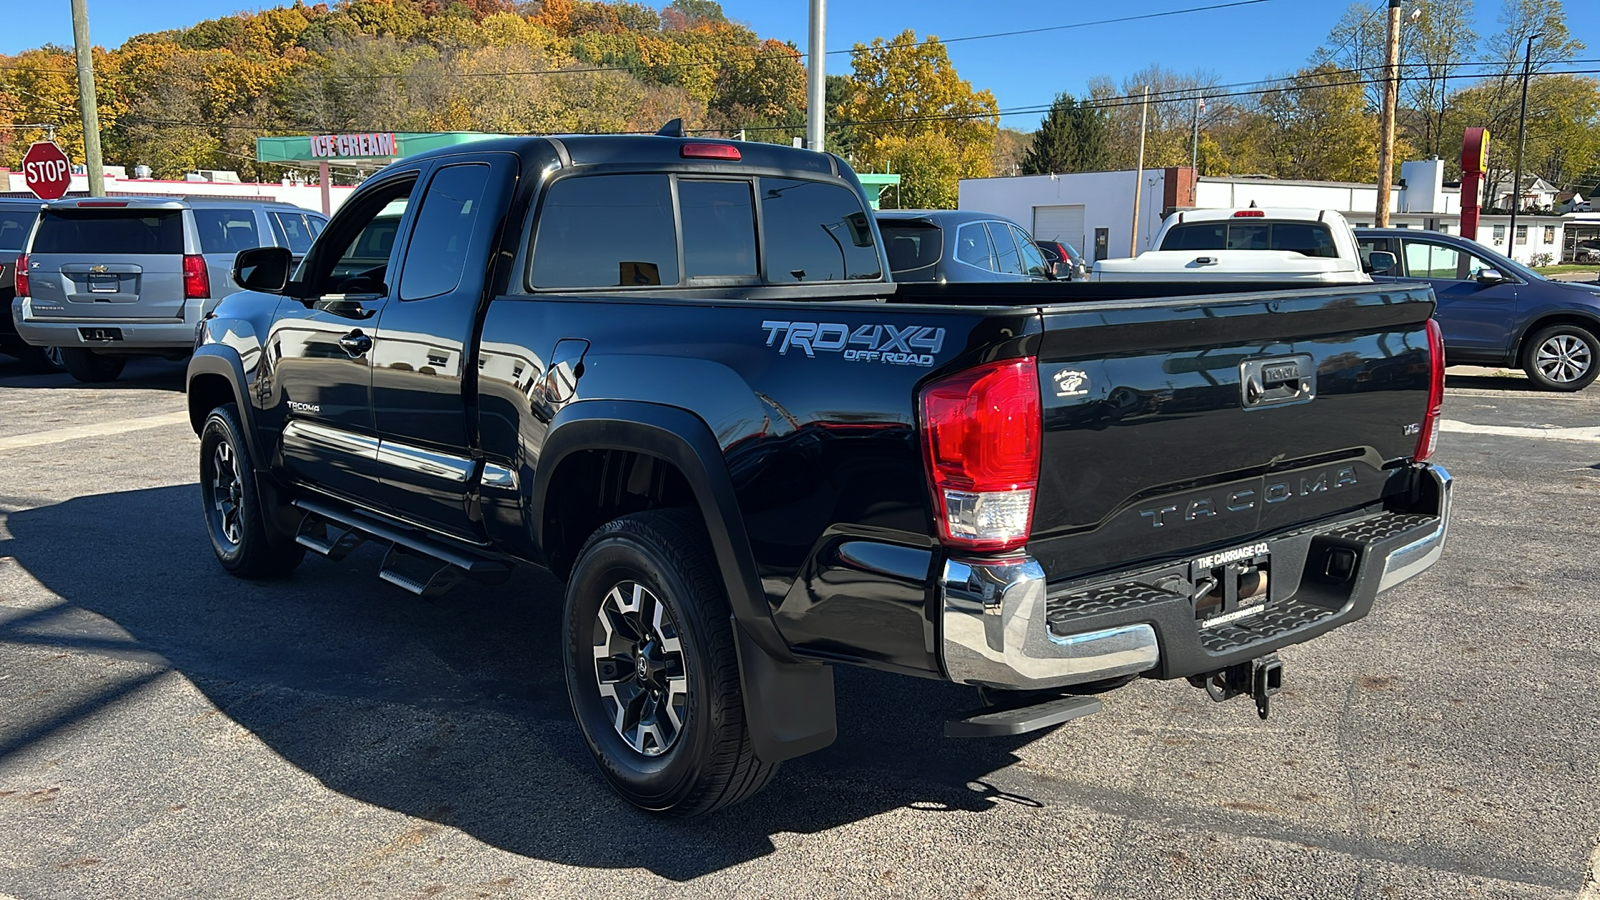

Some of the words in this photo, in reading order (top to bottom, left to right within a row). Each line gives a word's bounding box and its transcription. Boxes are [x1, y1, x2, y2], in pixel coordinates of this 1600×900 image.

[310, 135, 337, 157] ICE
[338, 133, 396, 156] CREAM
[26, 160, 67, 184] STOP
[843, 349, 880, 363] OFF
[880, 352, 935, 368] ROAD
[1267, 366, 1299, 381] TOYOTA
[287, 400, 320, 412] TACOMA
[1402, 422, 1420, 436] V6
[1138, 465, 1358, 528] TACOMA
[1197, 555, 1214, 569] THE
[1213, 545, 1255, 565] CARRIAGE
[1254, 542, 1271, 555] CO.
